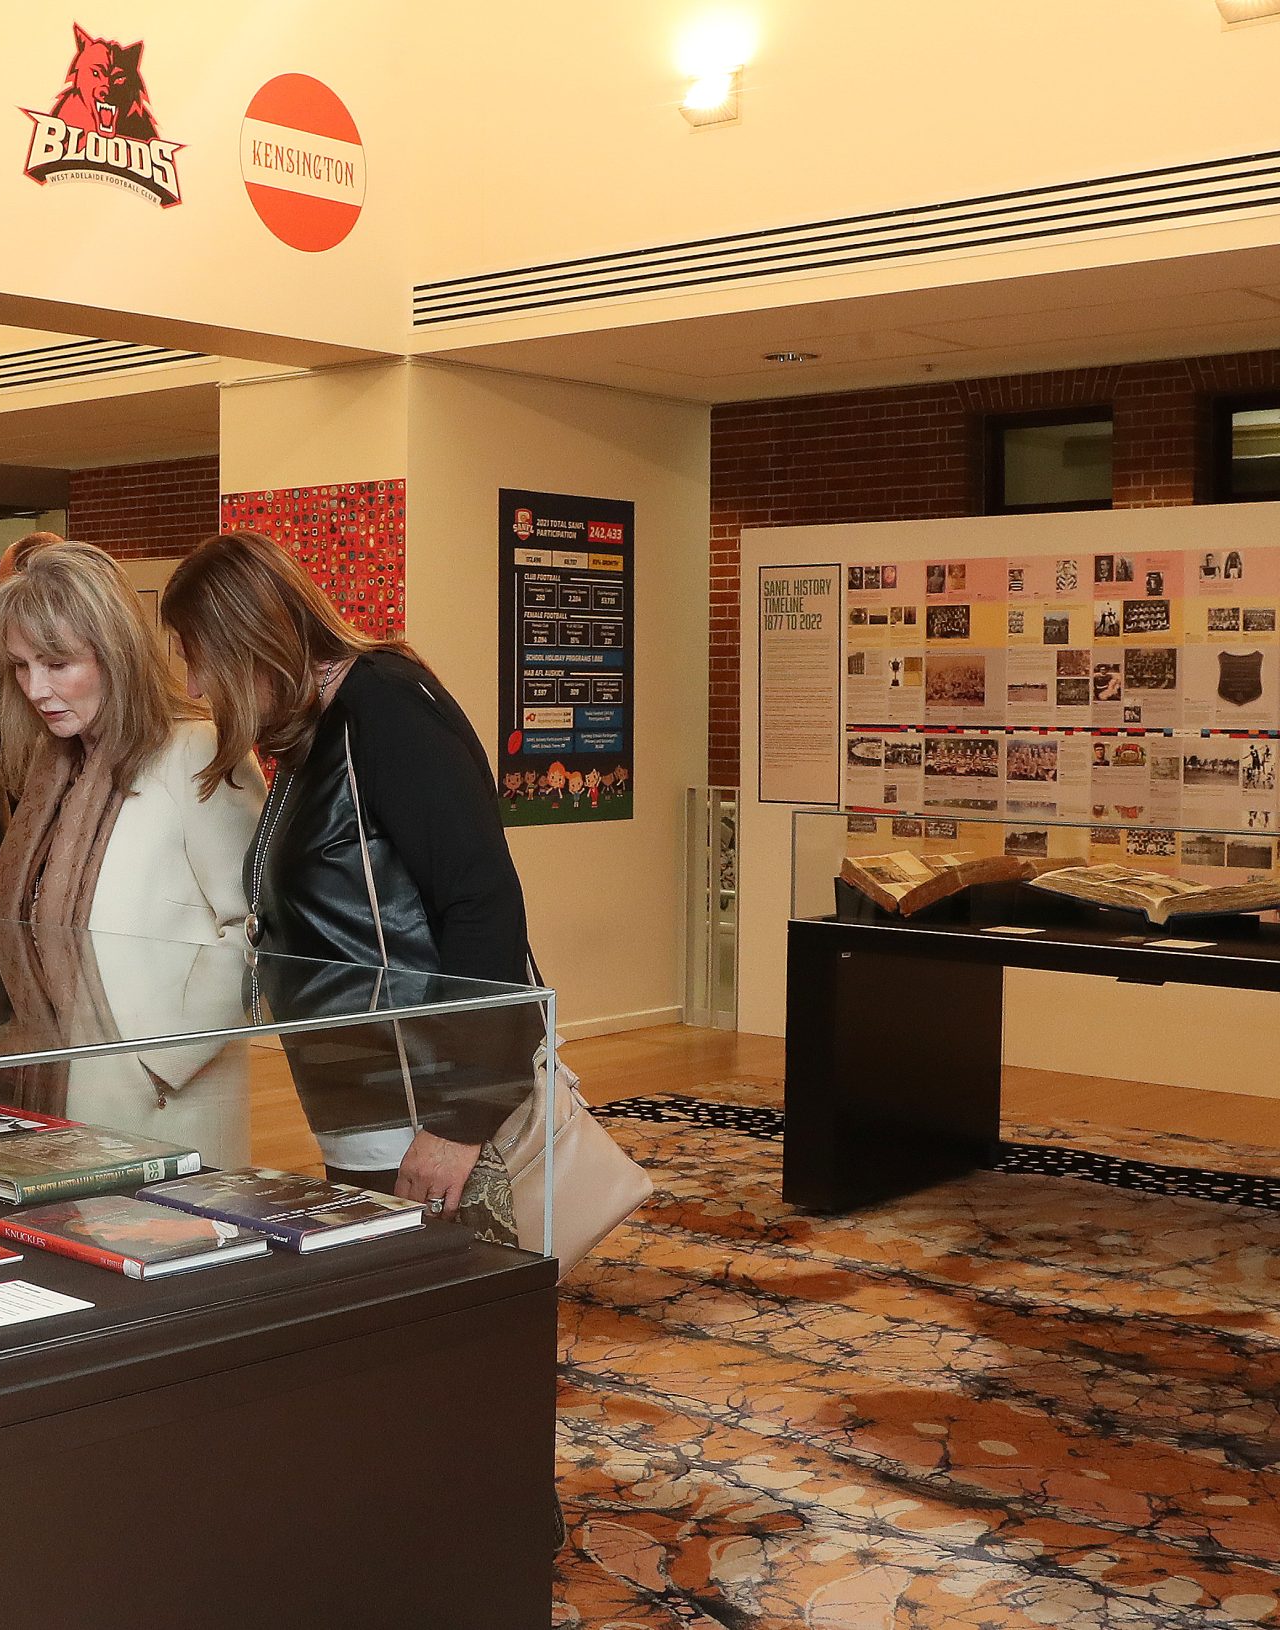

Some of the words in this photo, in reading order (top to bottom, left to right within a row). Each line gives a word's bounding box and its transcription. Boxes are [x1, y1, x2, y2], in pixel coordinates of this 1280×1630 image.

[27, 111, 183, 199] BLOODS
[252, 140, 355, 189] KENSINGTON
[50, 173, 68, 183] WEST
[71, 172, 104, 182] ADELAIDE
[106, 174, 139, 193] FOOTBALL
[141, 190, 158, 203] CLUB
[536, 529, 577, 539] PARTICIPATION
[764, 580, 790, 596] SANFL
[793, 579, 831, 596] HISTORY
[764, 597, 804, 613] TIMELINE
[764, 614, 783, 630] 1877
[786, 614, 797, 630] TO
[800, 613, 822, 630] 2022
[4, 1227, 46, 1248] KNUCKLES
